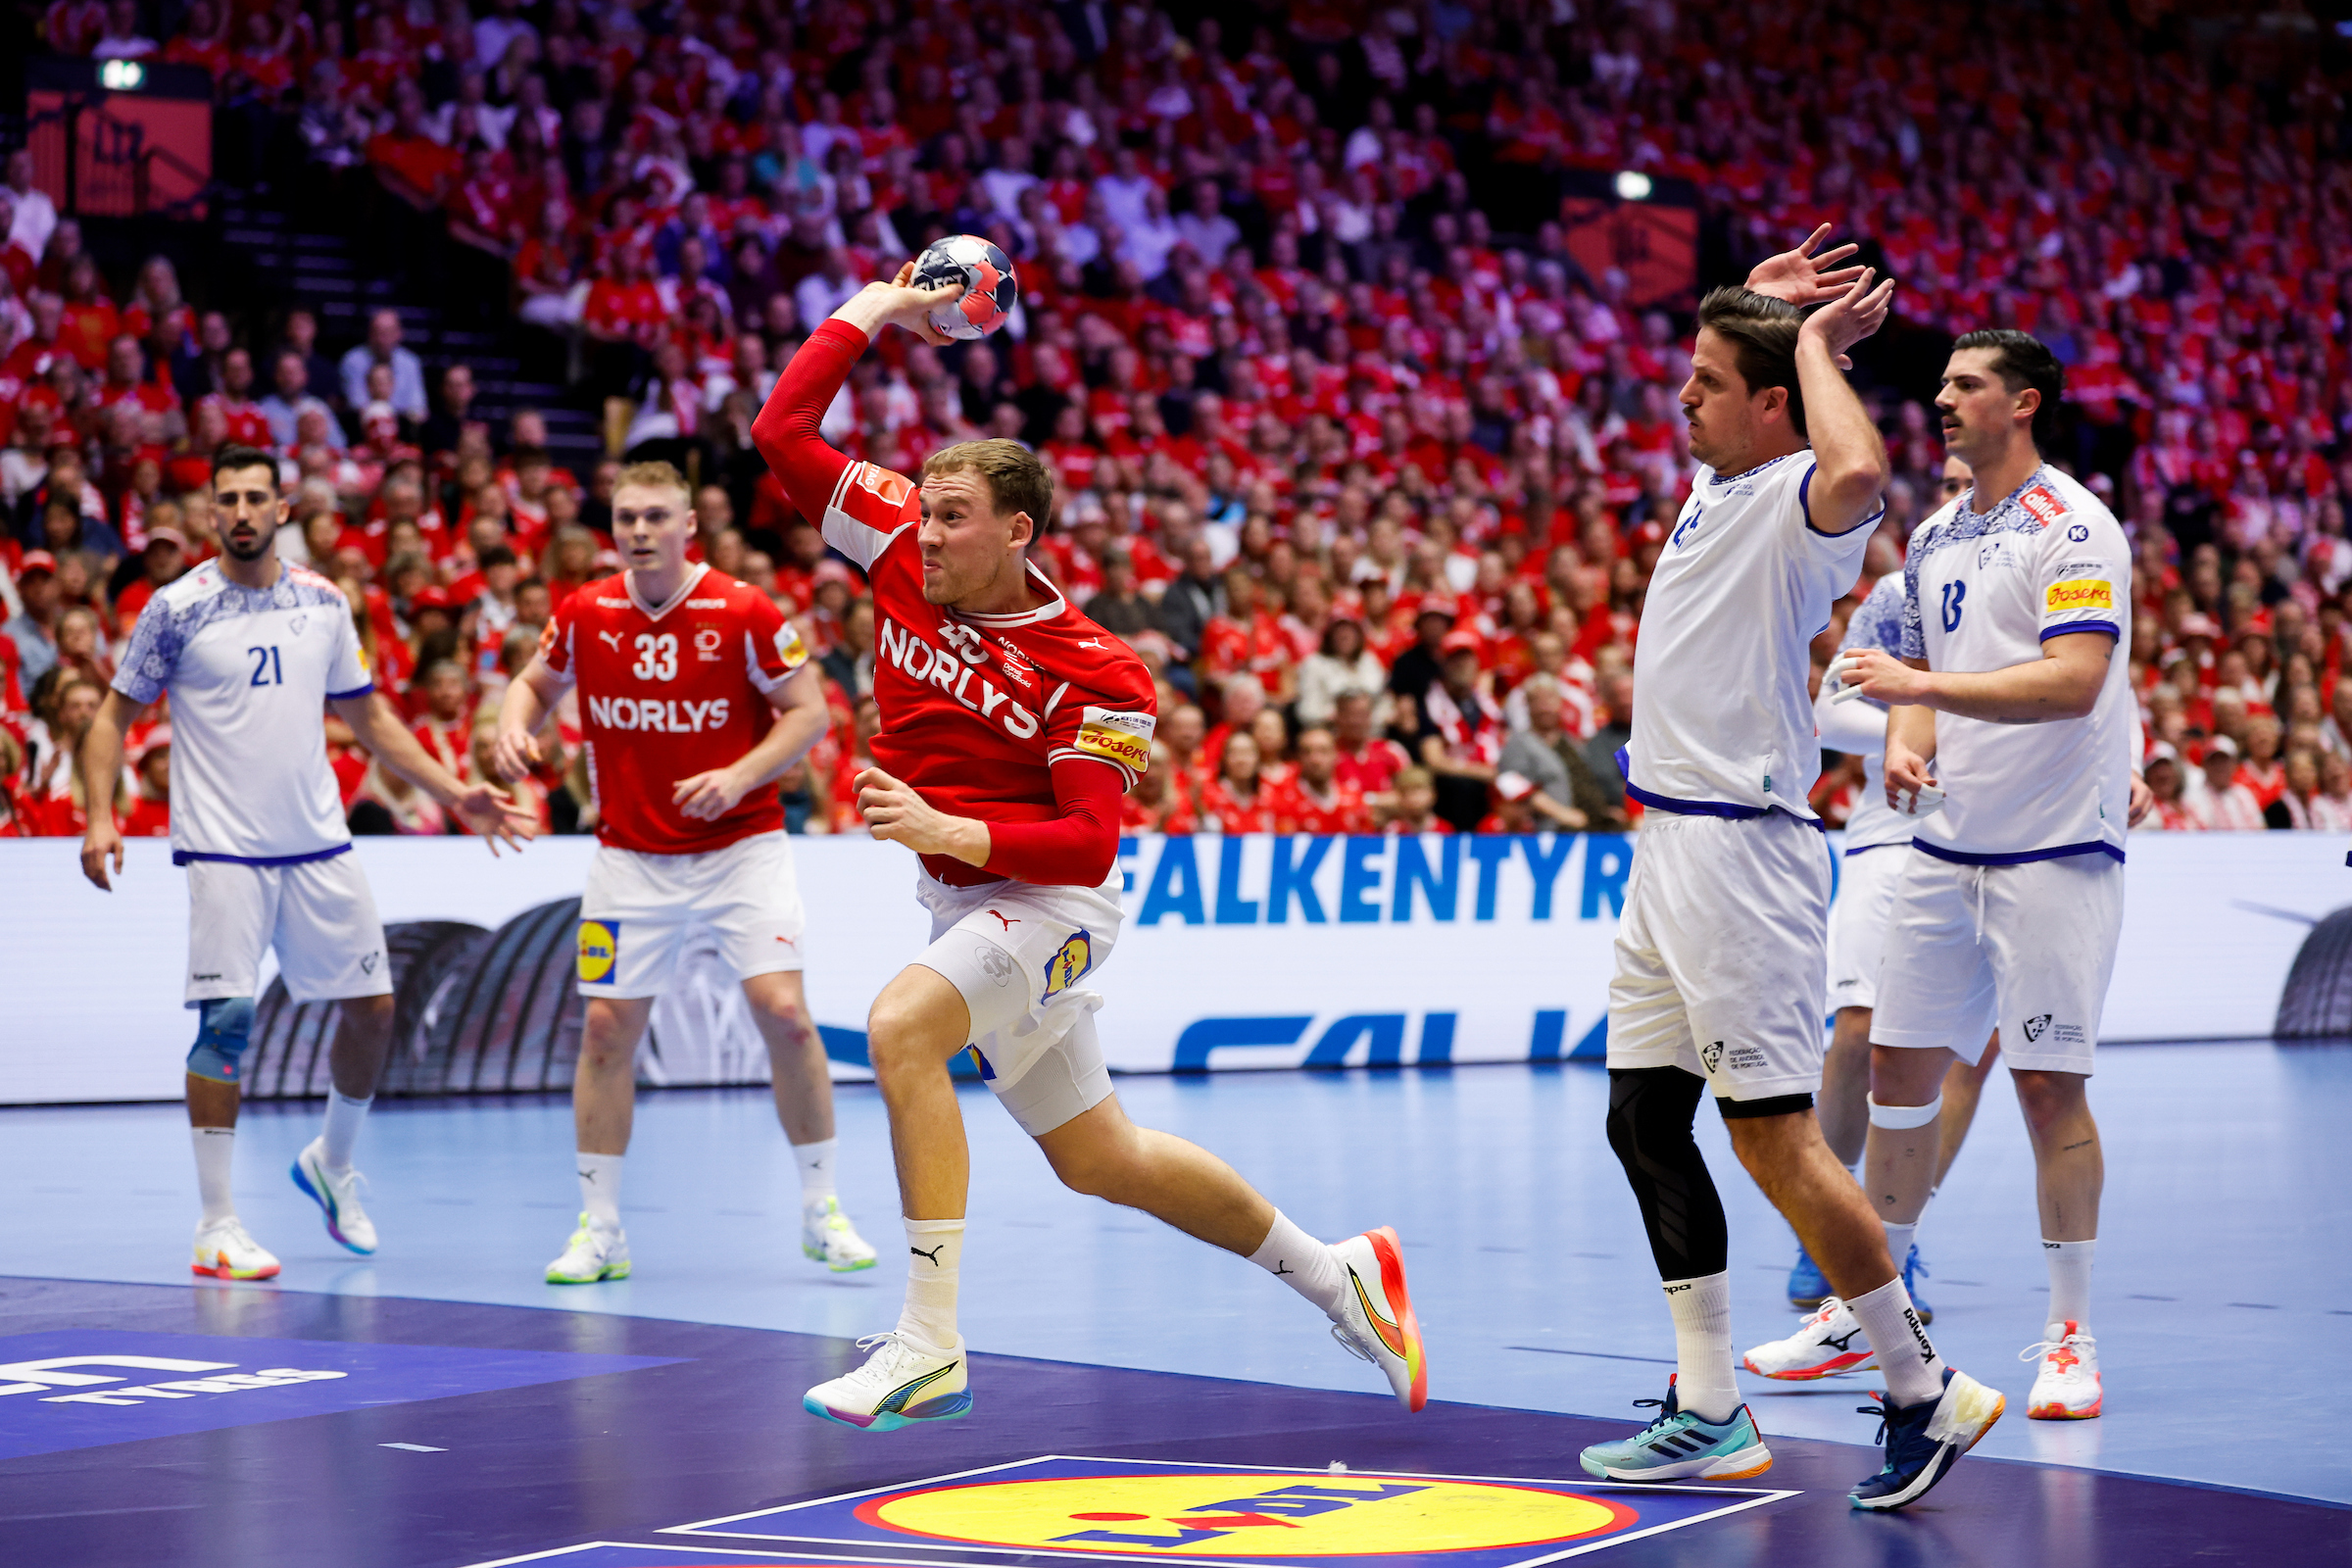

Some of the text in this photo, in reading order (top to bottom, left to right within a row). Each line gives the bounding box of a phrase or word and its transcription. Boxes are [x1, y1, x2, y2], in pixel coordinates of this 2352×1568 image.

[1942, 580, 1966, 633] 13
[2048, 587, 2111, 606] Josera
[248, 645, 283, 687] 21
[633, 633, 678, 682] 33
[880, 617, 1039, 739] NORLYS
[589, 695, 730, 733] NORLYS
[1903, 1307, 1936, 1365] Kempa
[37, 1368, 349, 1406] TYRES
